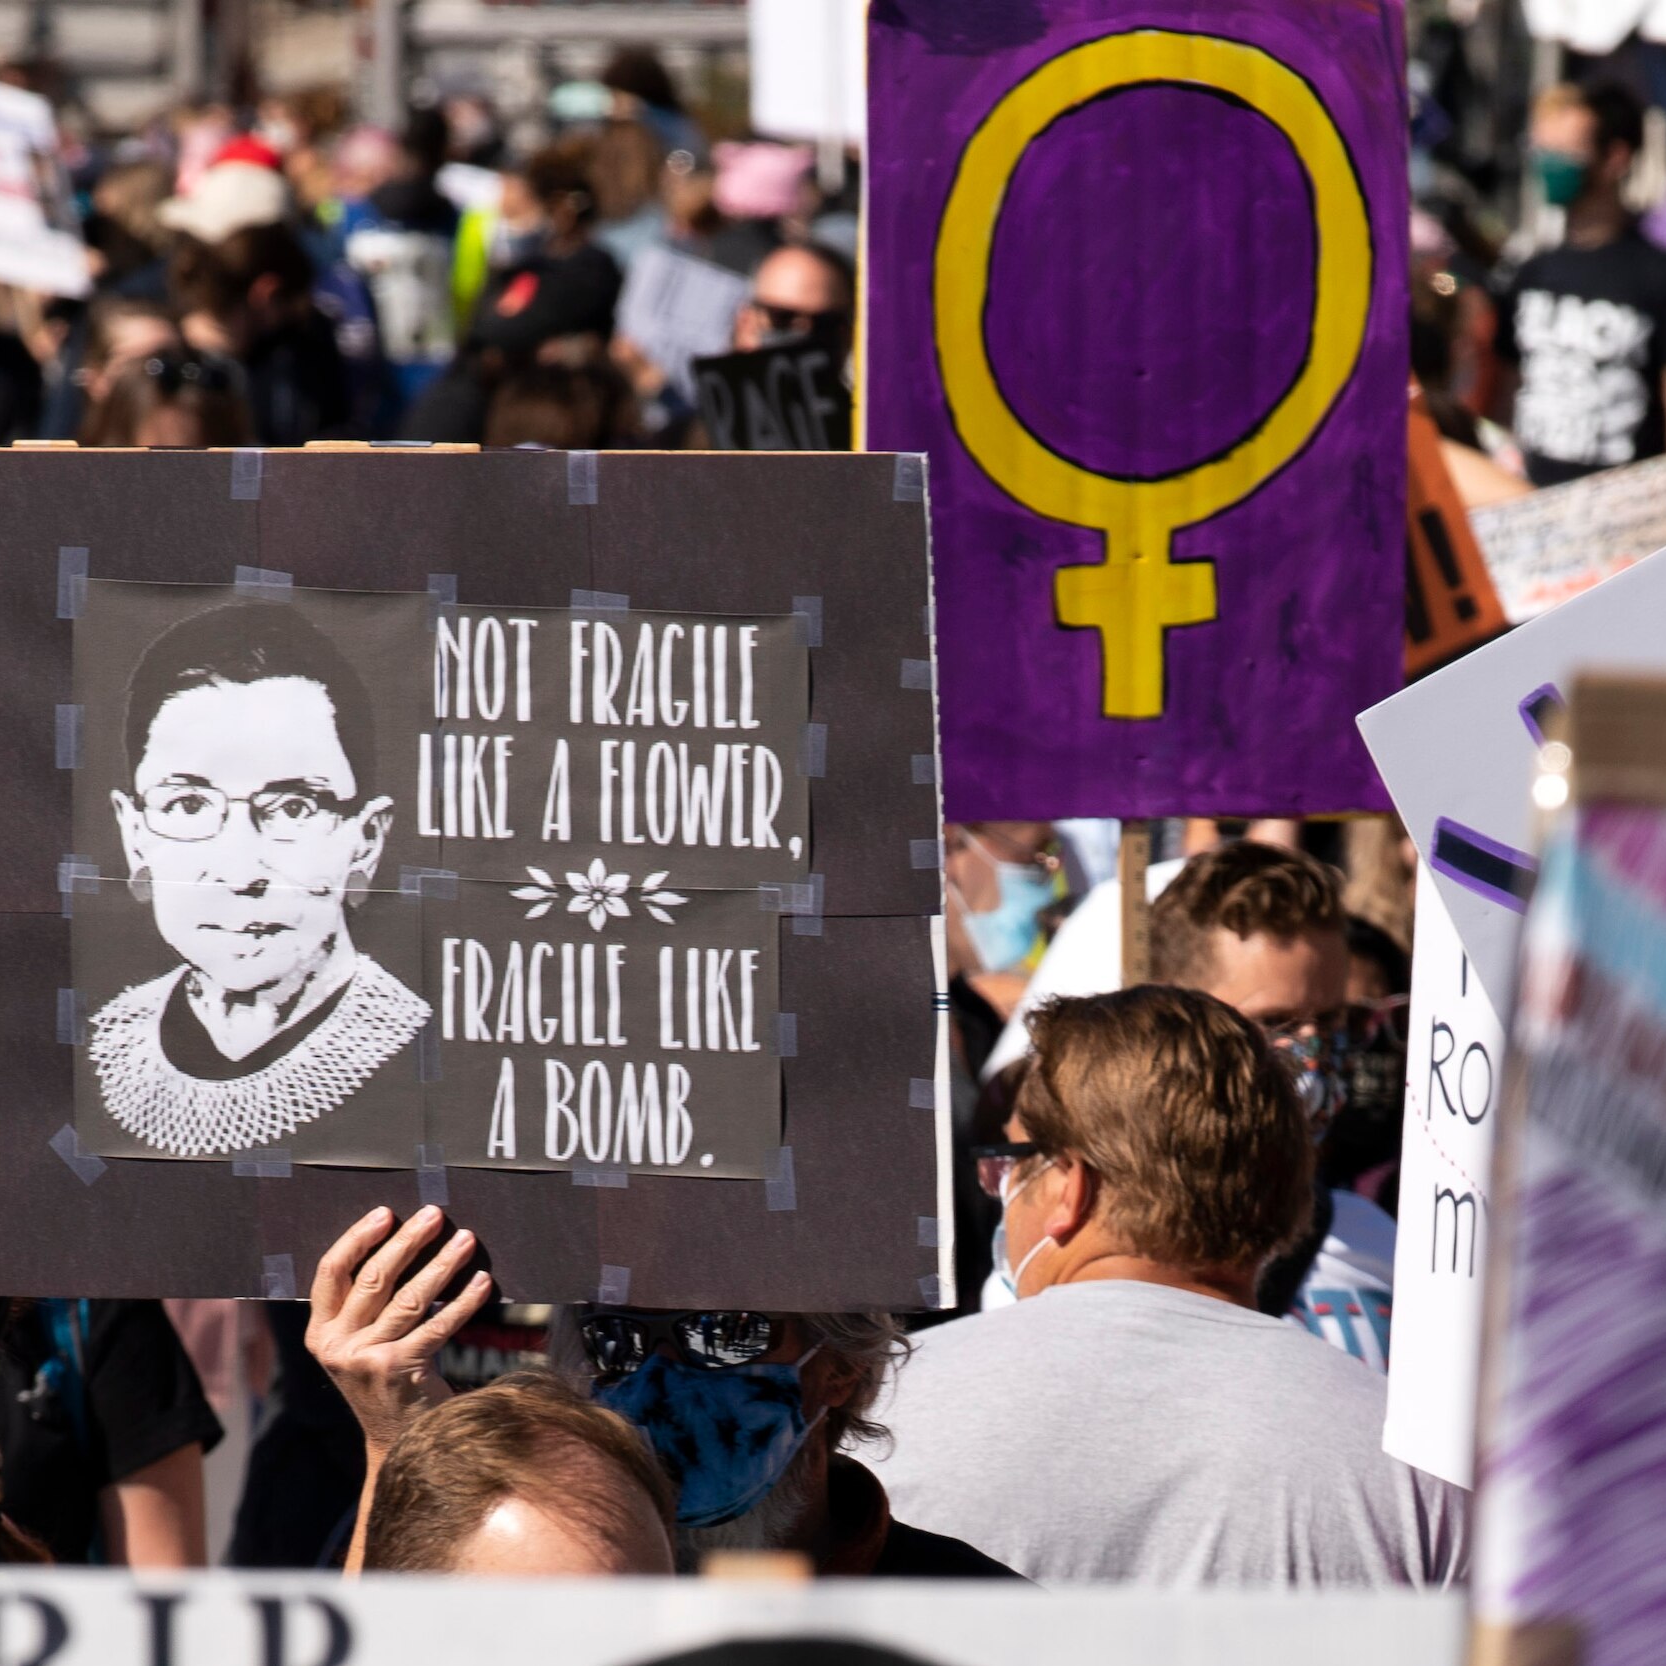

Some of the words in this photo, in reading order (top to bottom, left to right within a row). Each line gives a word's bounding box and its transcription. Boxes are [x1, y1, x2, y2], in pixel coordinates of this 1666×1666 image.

[433, 616, 538, 723] NOT
[570, 621, 760, 730] FRAGILE
[417, 734, 515, 838] LIKE
[542, 738, 571, 842] A
[599, 740, 803, 860] FLOWER,
[441, 937, 627, 1047] FRAGILE
[658, 948, 761, 1052] LIKE
[488, 1056, 517, 1160] A
[545, 1062, 714, 1168] BOMB.
